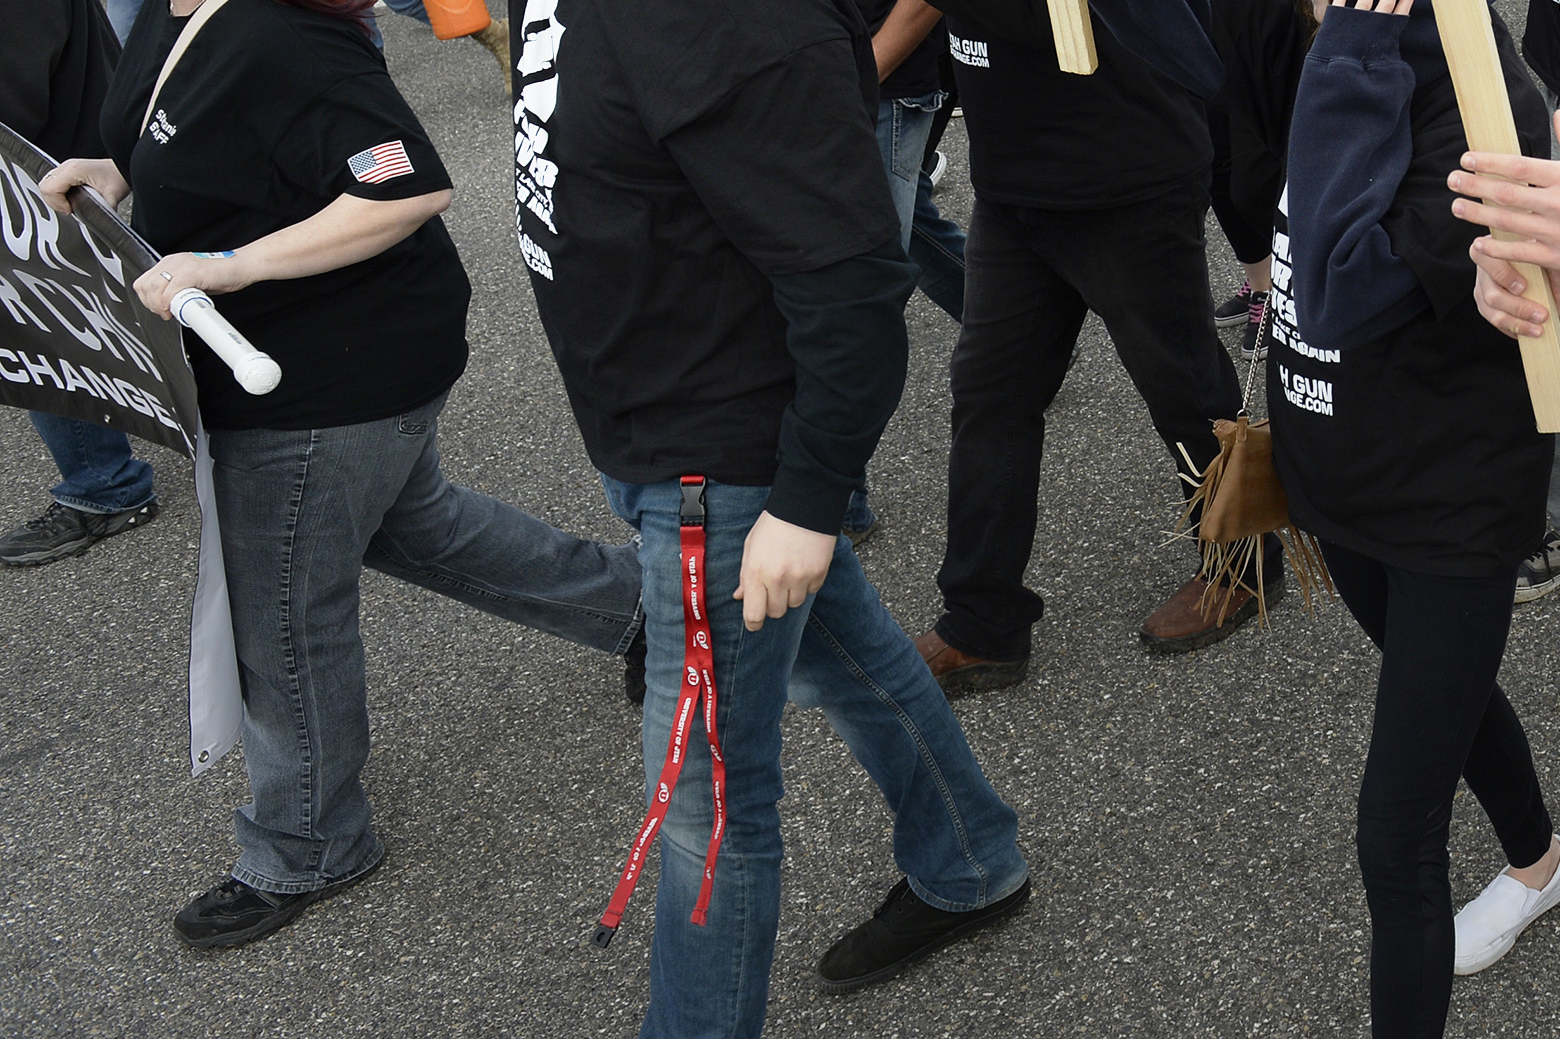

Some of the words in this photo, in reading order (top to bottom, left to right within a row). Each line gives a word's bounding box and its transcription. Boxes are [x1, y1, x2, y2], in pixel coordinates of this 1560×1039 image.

[962, 39, 988, 57] GUN
[1289, 337, 1340, 363] AGAIN
[1292, 374, 1333, 403] GUN
